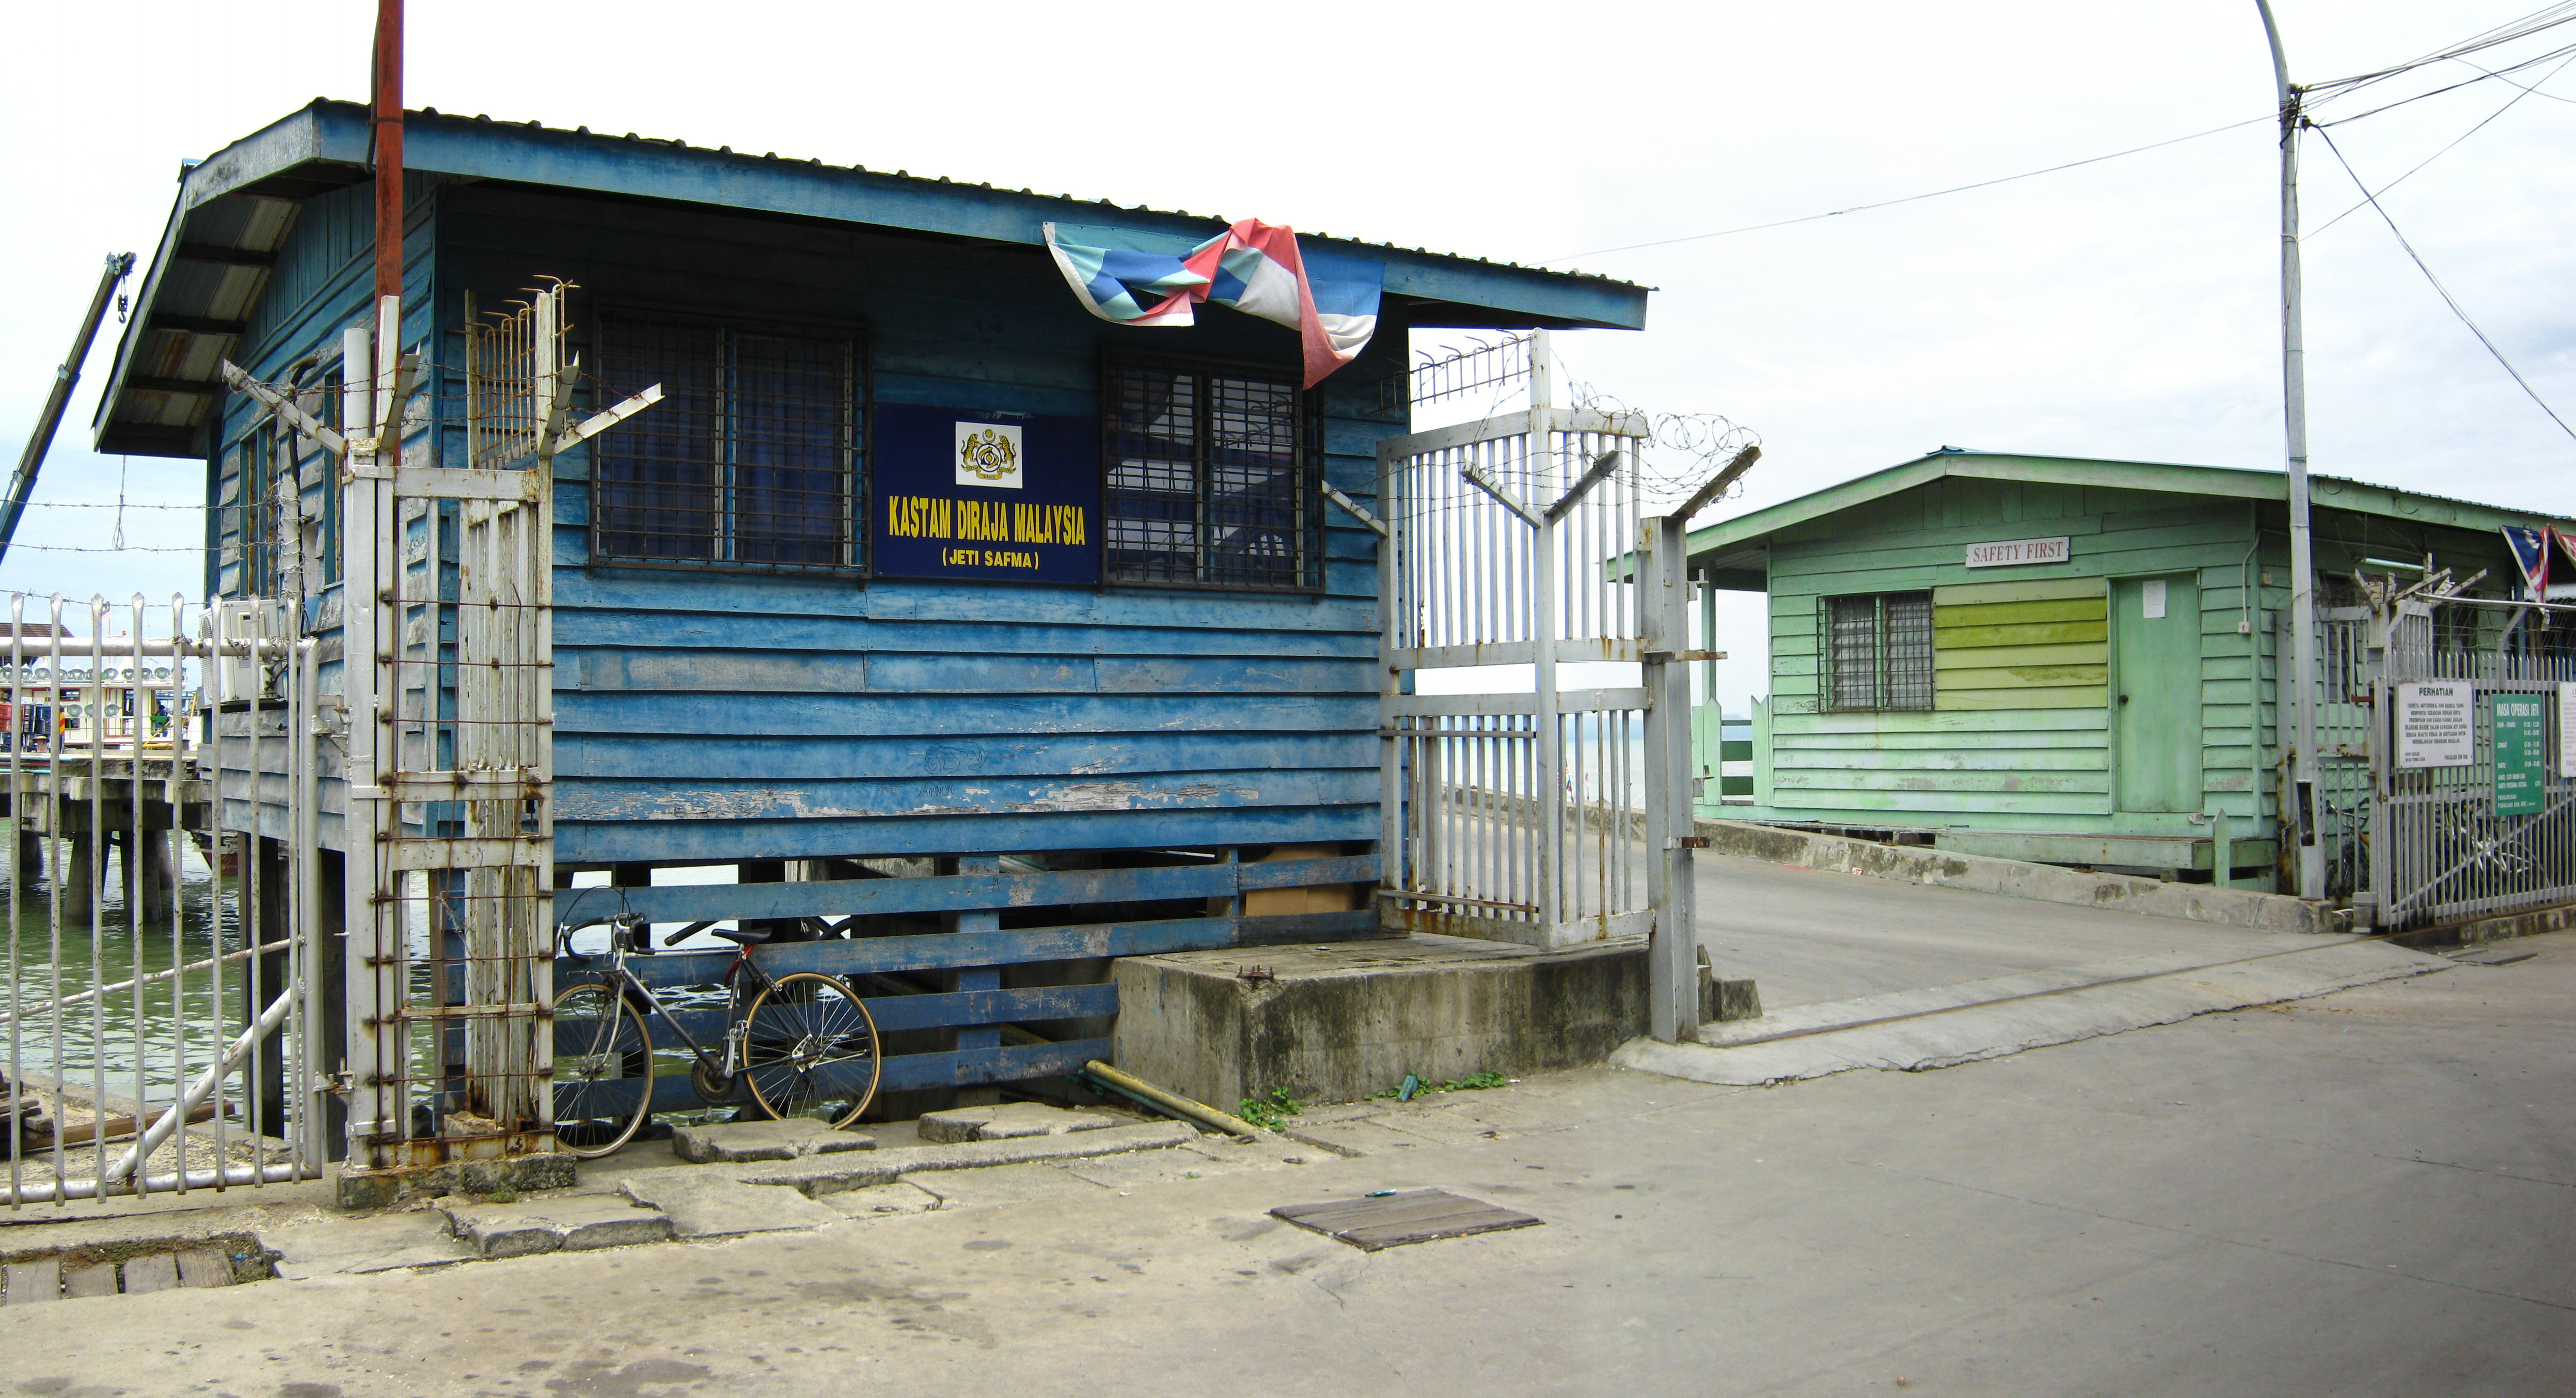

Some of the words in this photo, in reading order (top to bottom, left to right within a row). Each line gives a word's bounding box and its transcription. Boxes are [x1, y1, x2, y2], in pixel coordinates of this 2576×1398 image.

[889, 495, 951, 539] KASTAM
[957, 499, 1009, 542] DIRAJA
[1014, 503, 1085, 545] MALAYSIA
[1973, 544, 2021, 562] SAFETY
[2027, 541, 2063, 559] FIRST
[2419, 687, 2453, 696] PERHATIAN
[2496, 703, 2509, 716] MASA
[2511, 703, 2530, 716] OPERASI
[2531, 703, 2539, 716] JETI
